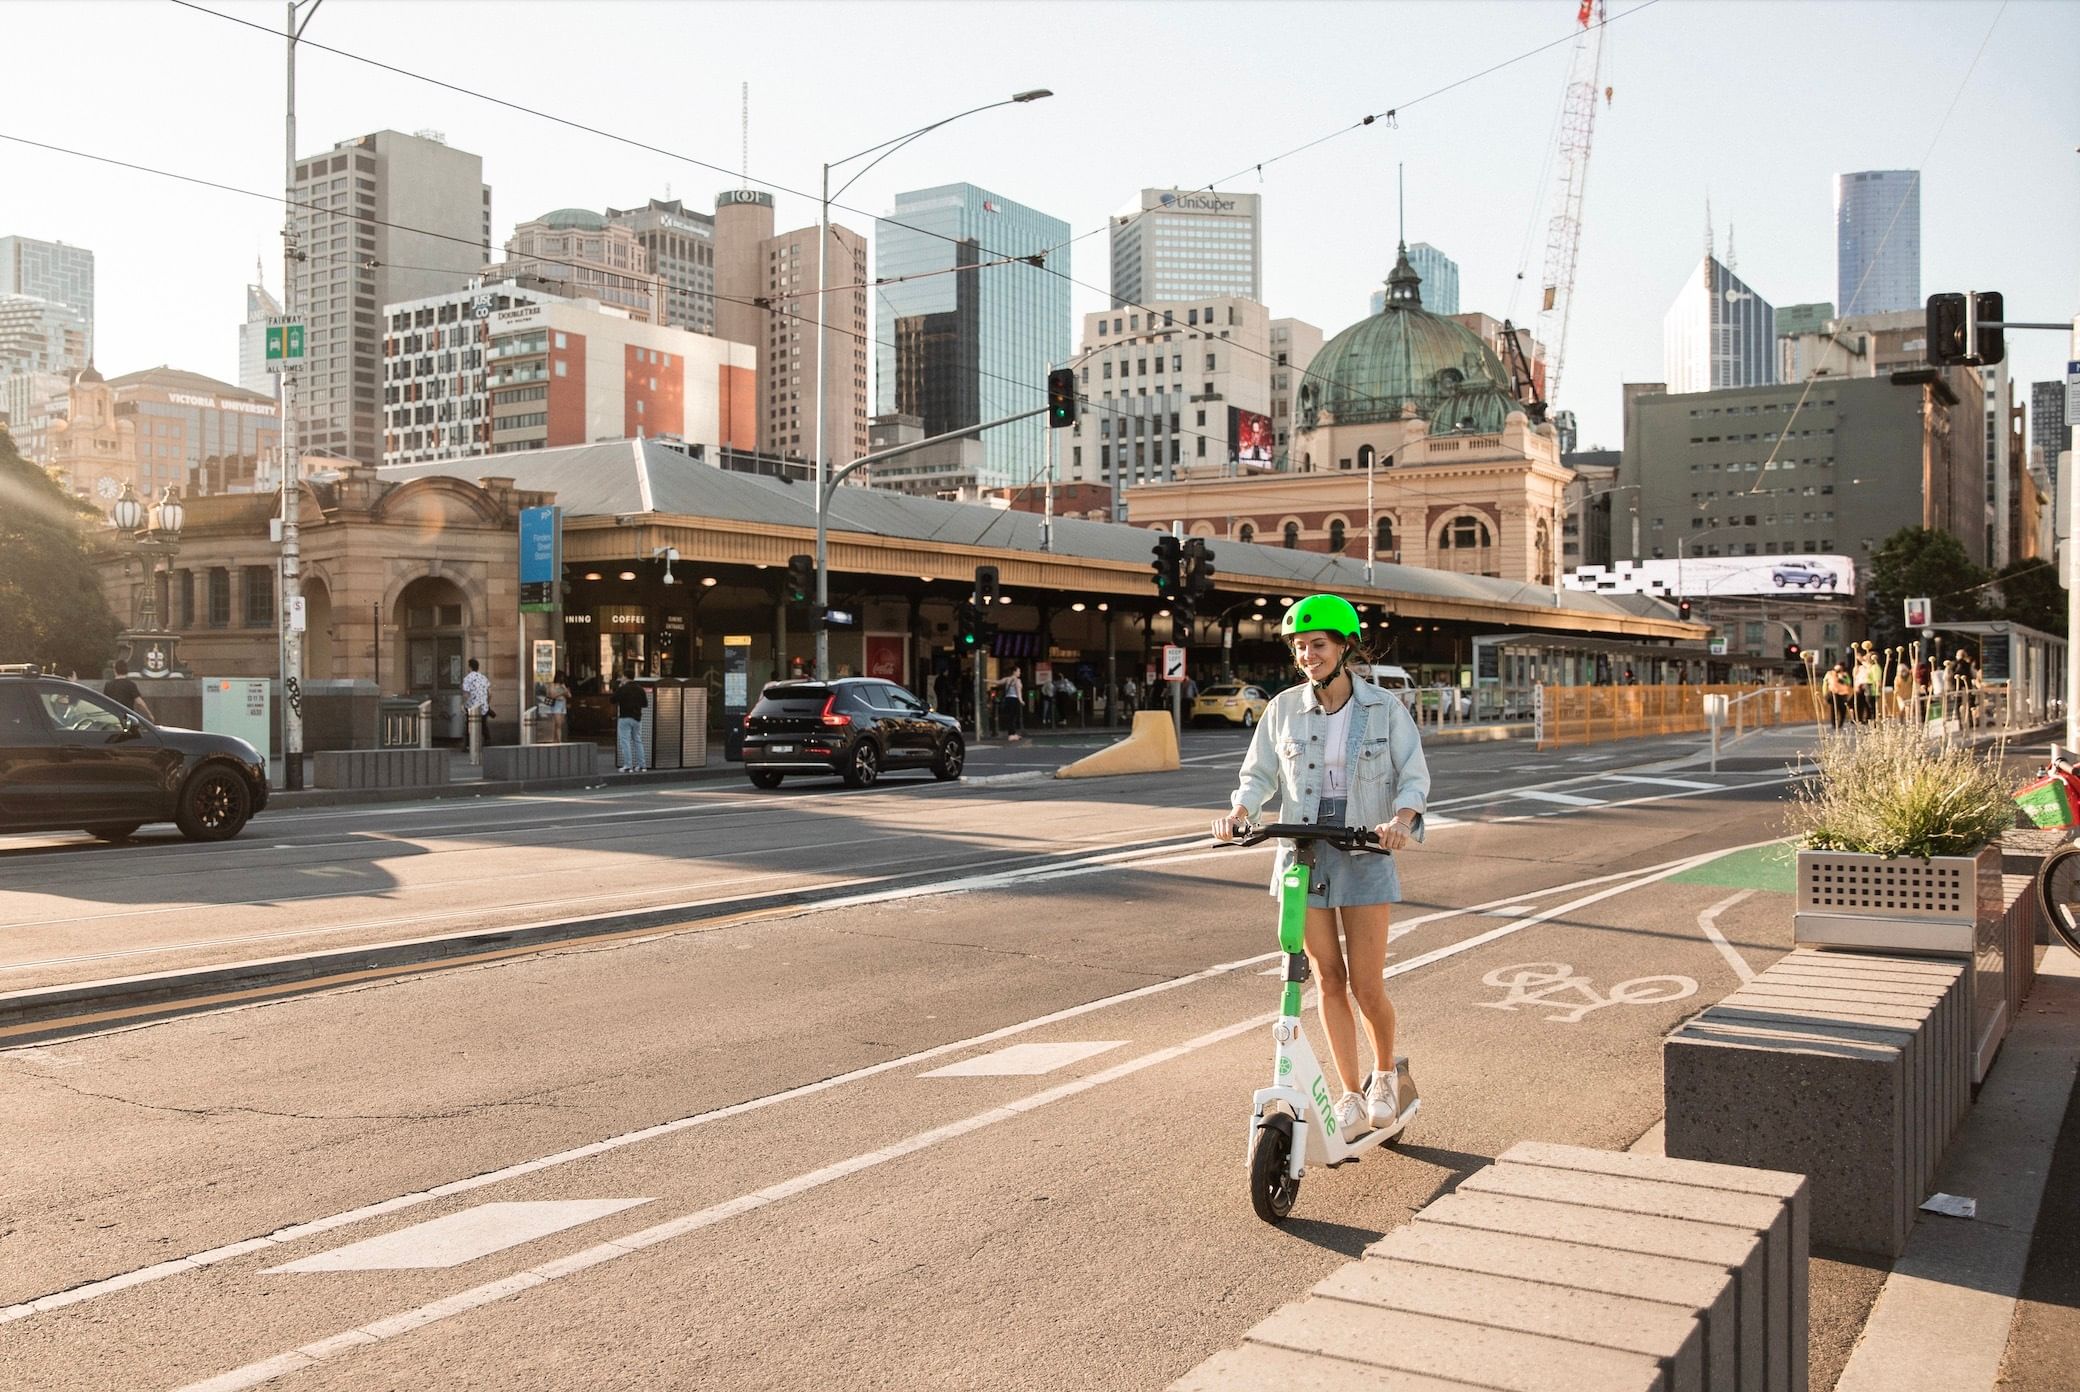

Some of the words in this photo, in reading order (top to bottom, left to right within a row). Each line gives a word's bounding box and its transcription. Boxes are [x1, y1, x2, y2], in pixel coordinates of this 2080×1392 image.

[1177, 195, 1236, 213] UniSuper
[268, 315, 302, 325] FAIRWAY
[267, 366, 281, 374] ALL
[283, 364, 305, 372] TIMES
[168, 392, 216, 408] VICTORIA
[220, 399, 276, 416] UNIVERSITY
[565, 615, 591, 623] INING
[612, 615, 645, 624] COFFEE
[1312, 1075, 1336, 1136] Lime
